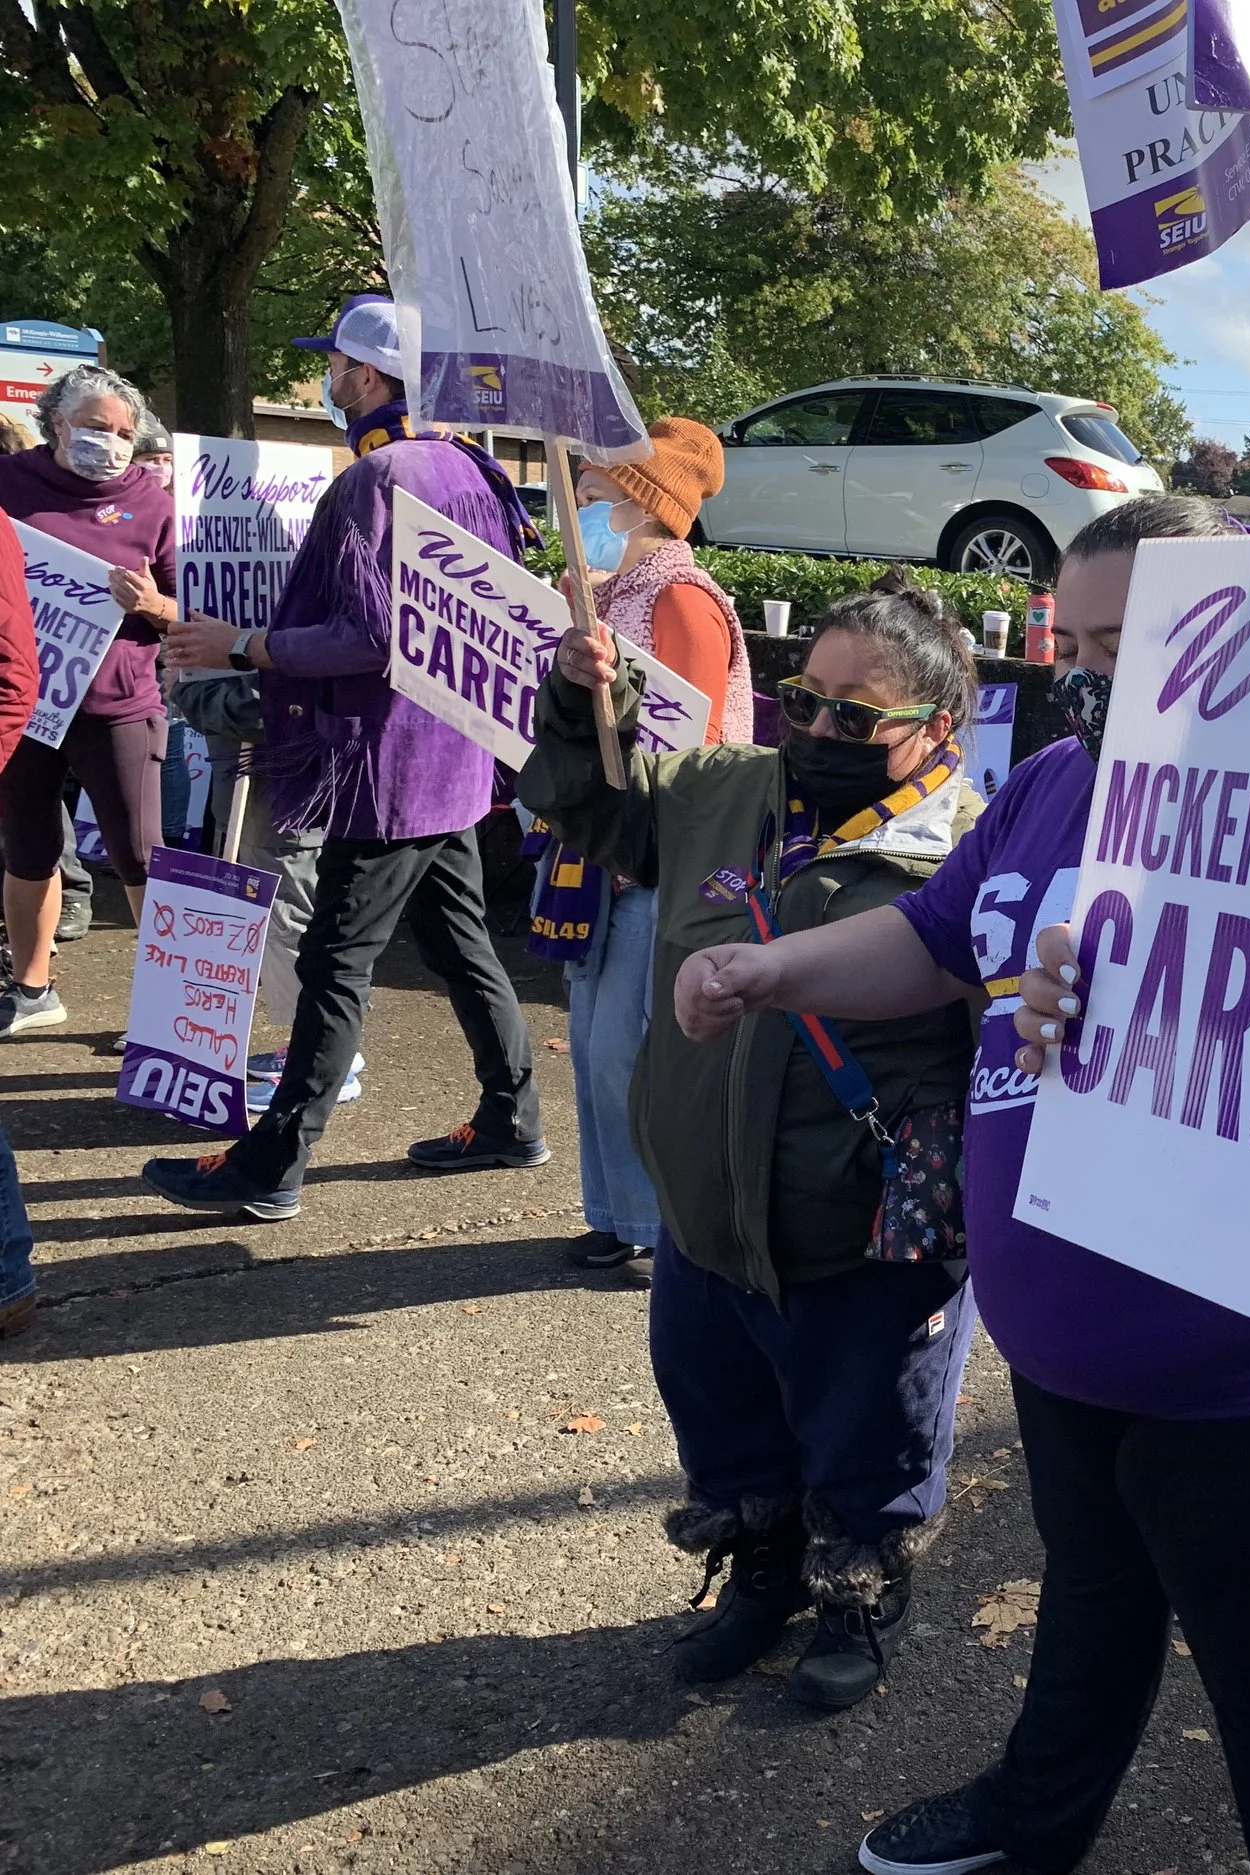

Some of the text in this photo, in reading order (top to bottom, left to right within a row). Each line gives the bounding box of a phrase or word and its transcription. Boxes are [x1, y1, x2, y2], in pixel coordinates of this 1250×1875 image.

[1160, 211, 1207, 249] SEIU
[474, 390, 504, 405] SEIU
[97, 504, 115, 519] STOP
[190, 453, 327, 520] We support
[417, 530, 506, 600] We
[715, 870, 747, 892] STOP
[144, 943, 254, 994] TREATED LIKE
[173, 1015, 239, 1071] CALLED
[129, 1057, 233, 1126] SEIU
